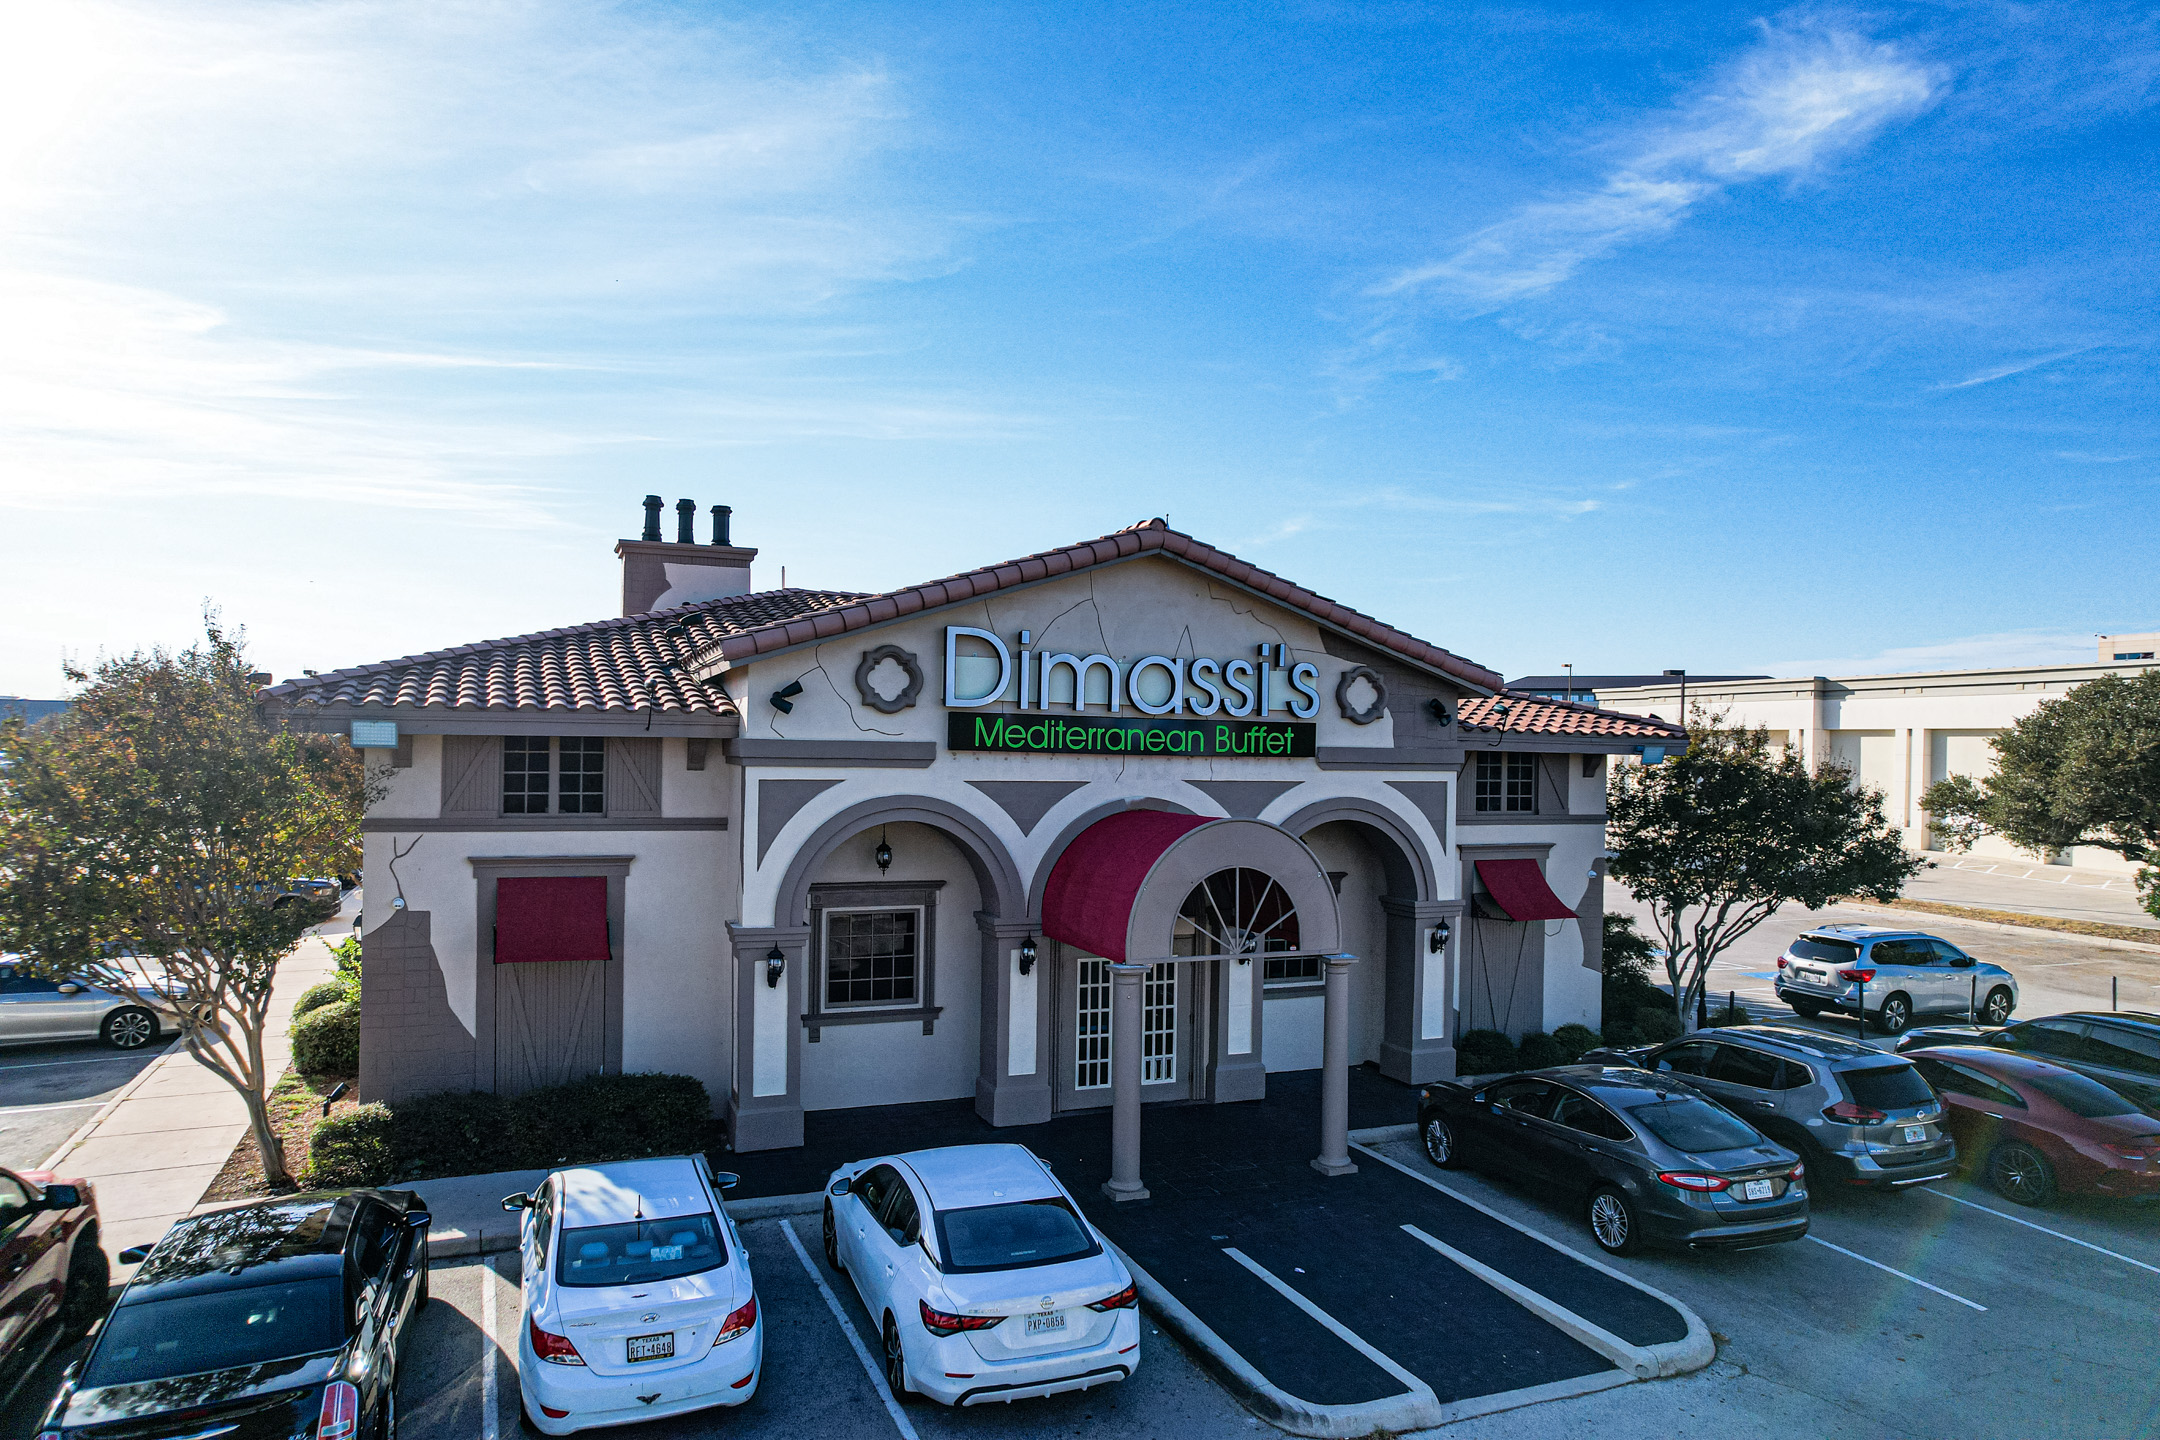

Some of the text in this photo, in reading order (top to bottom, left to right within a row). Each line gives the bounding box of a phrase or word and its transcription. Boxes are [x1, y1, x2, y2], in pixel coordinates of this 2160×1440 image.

[944, 625, 1320, 719] Dimassi's
[974, 716, 1295, 754] Mediterranean Buffet
[641, 1336, 660, 1344] TEXAS
